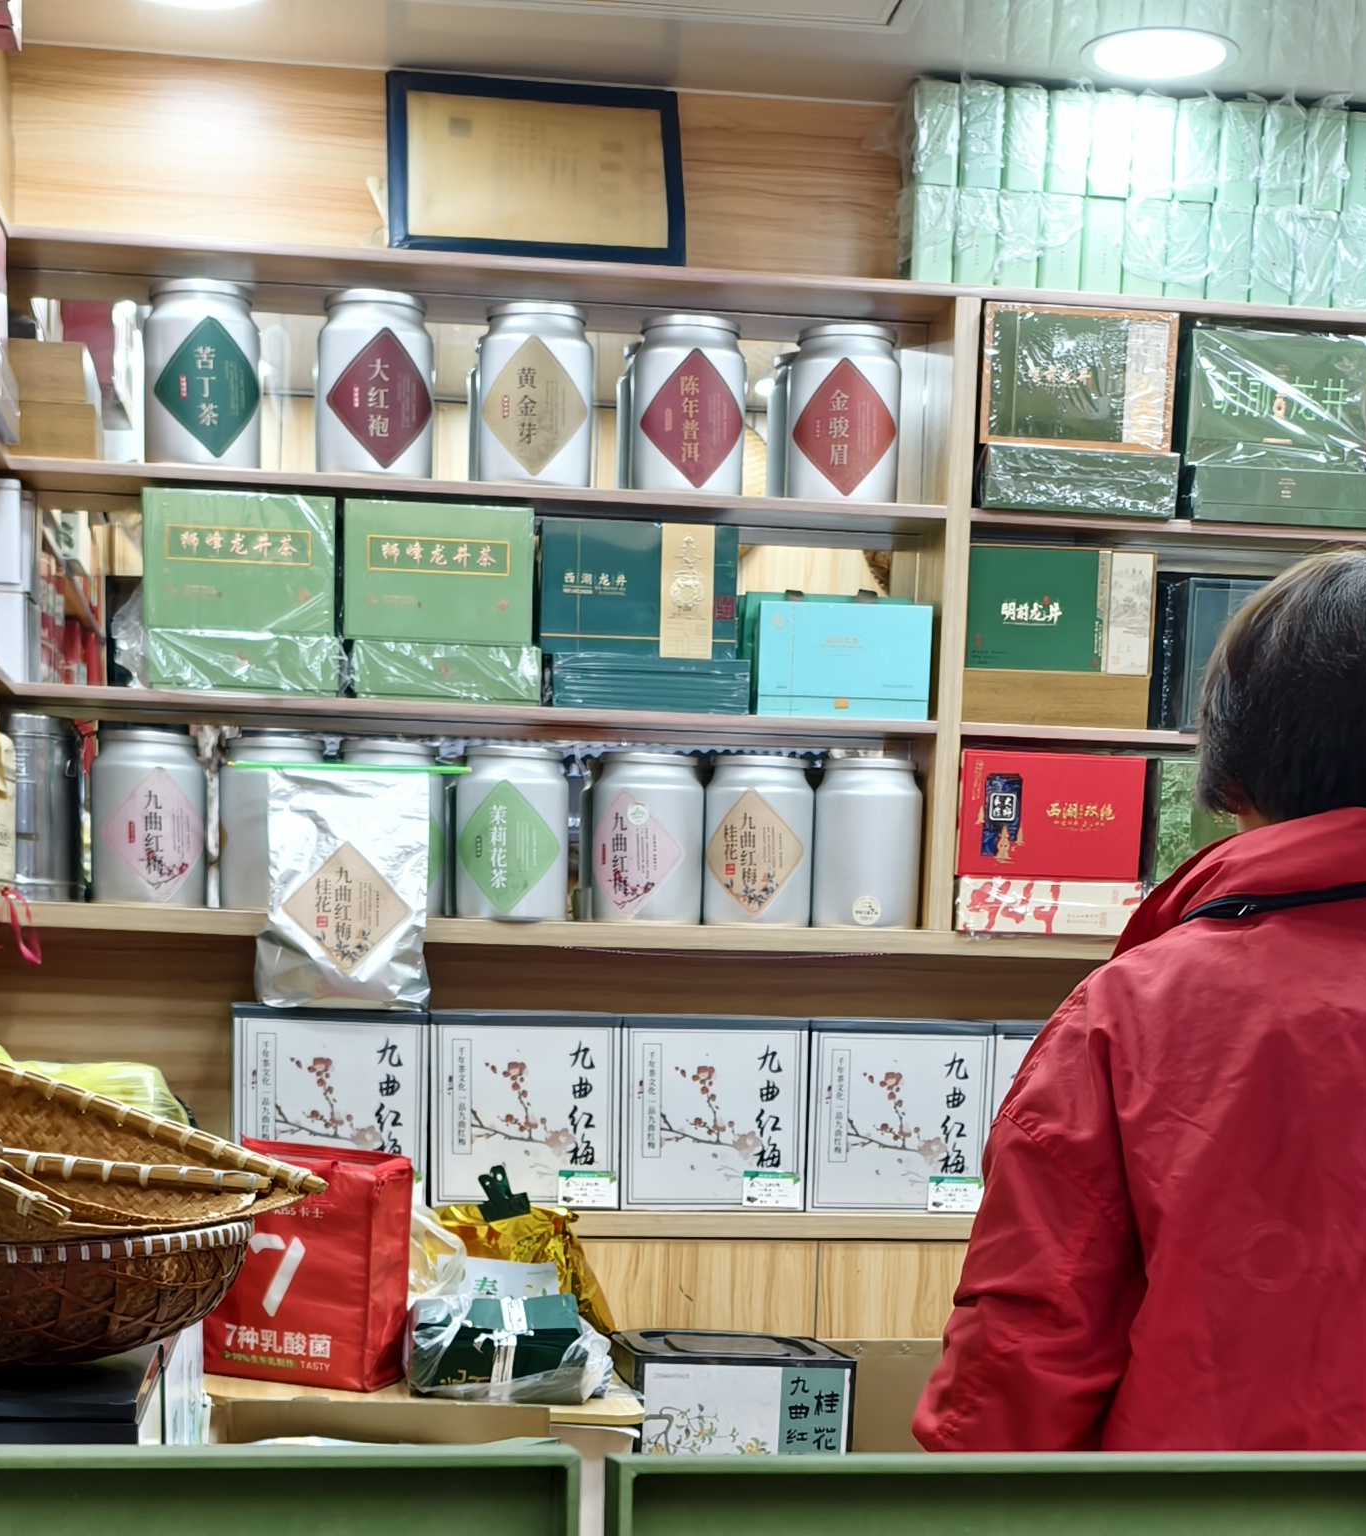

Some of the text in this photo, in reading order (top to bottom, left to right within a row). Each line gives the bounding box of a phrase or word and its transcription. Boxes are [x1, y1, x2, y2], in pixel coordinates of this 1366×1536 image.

[192, 345, 220, 428] 苦丁茶
[366, 357, 390, 439] 大红袍
[515, 367, 538, 446] 黄金芽
[679, 374, 701, 464] 陈年普洱
[827, 388, 850, 467] 金骏眉
[179, 529, 301, 559] 狮峰龙井茶
[380, 541, 498, 569] 狮峰龙井茶
[488, 805, 508, 889] 茉莉花茶
[723, 824, 738, 862] 桂花
[1046, 800, 1116, 821] 西湖双绝
[740, 812, 758, 887] 九曲红梅
[314, 877, 332, 914] 桂花
[333, 866, 353, 941] 九曲红梅
[566, 1039, 597, 1167] 九曲红梅
[755, 1043, 782, 1171] 九曲红梅
[941, 1050, 970, 1176] 九曲红梅
[299, 1205, 325, 1219] 卡士
[223, 1323, 332, 1360] 7种乳酸菌
[300, 1361, 331, 1373] TASTY
[786, 1375, 811, 1455] 九曲红
[812, 1389, 841, 1452] 桂花
